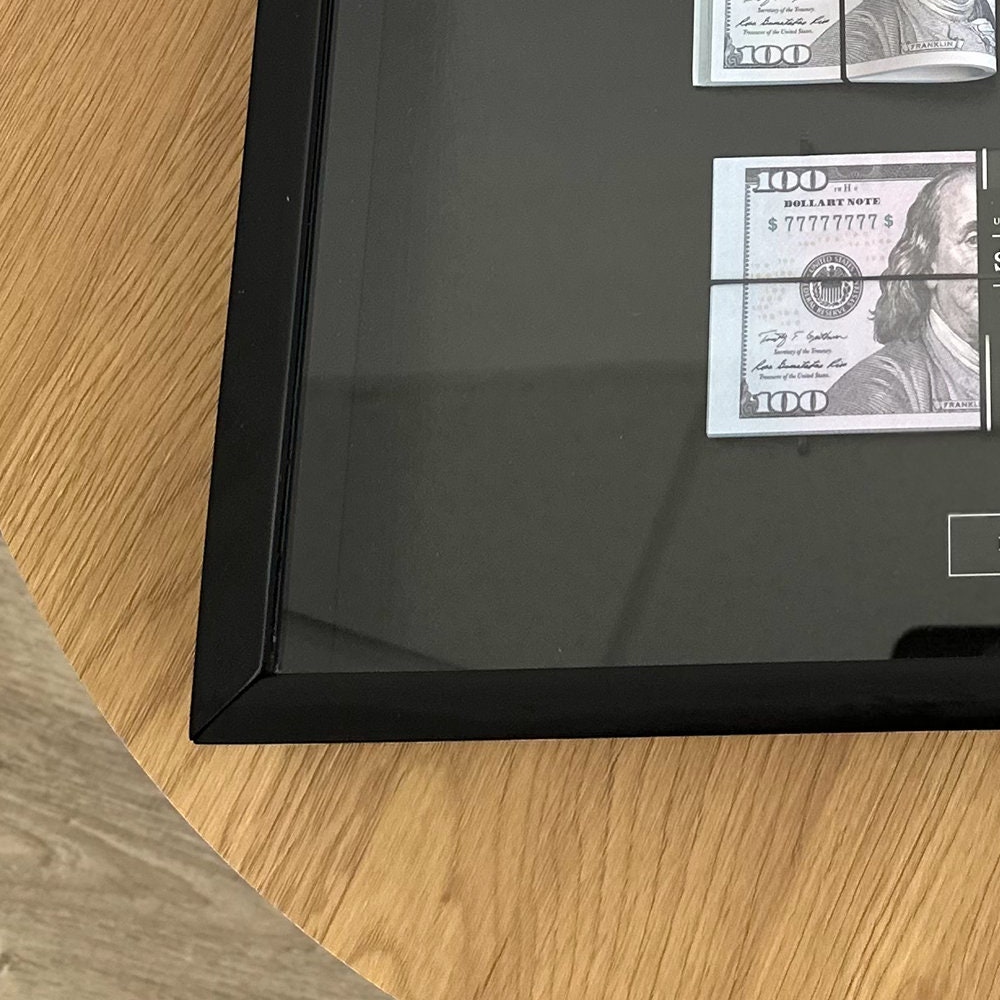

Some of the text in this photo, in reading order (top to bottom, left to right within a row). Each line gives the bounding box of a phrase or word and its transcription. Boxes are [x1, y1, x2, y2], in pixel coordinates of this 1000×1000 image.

[736, 44, 812, 66] 100
[910, 40, 954, 50] FRANKLIN
[752, 169, 829, 193] 100
[784, 197, 881, 208] DOLLART NOTE
[752, 390, 829, 413] 100
